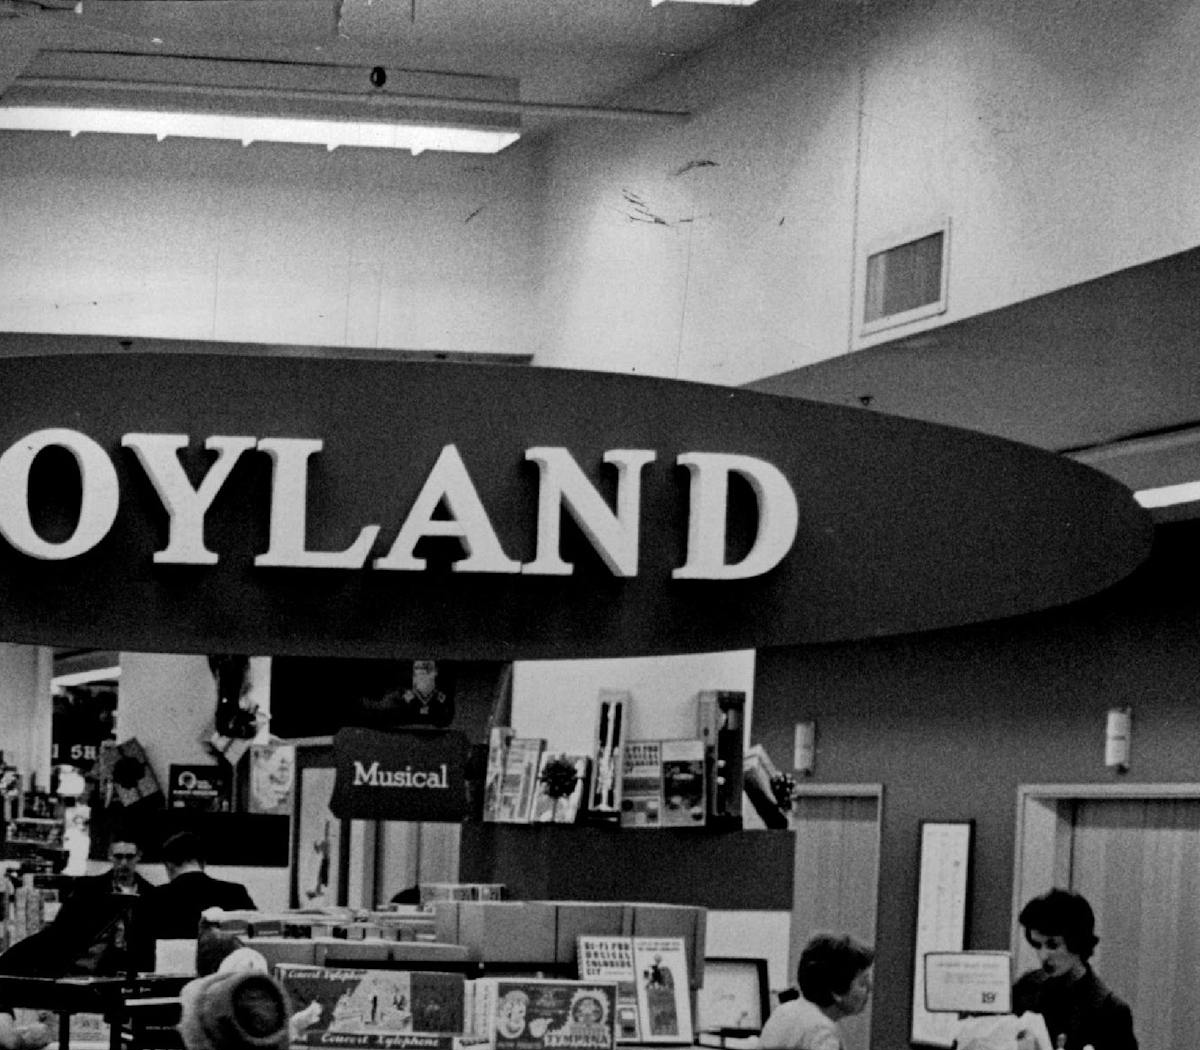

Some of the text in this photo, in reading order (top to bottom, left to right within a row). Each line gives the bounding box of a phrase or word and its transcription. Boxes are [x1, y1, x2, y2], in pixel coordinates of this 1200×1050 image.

[353, 760, 449, 788] Musical
[321, 1032, 439, 1049] Concert Xylophone
